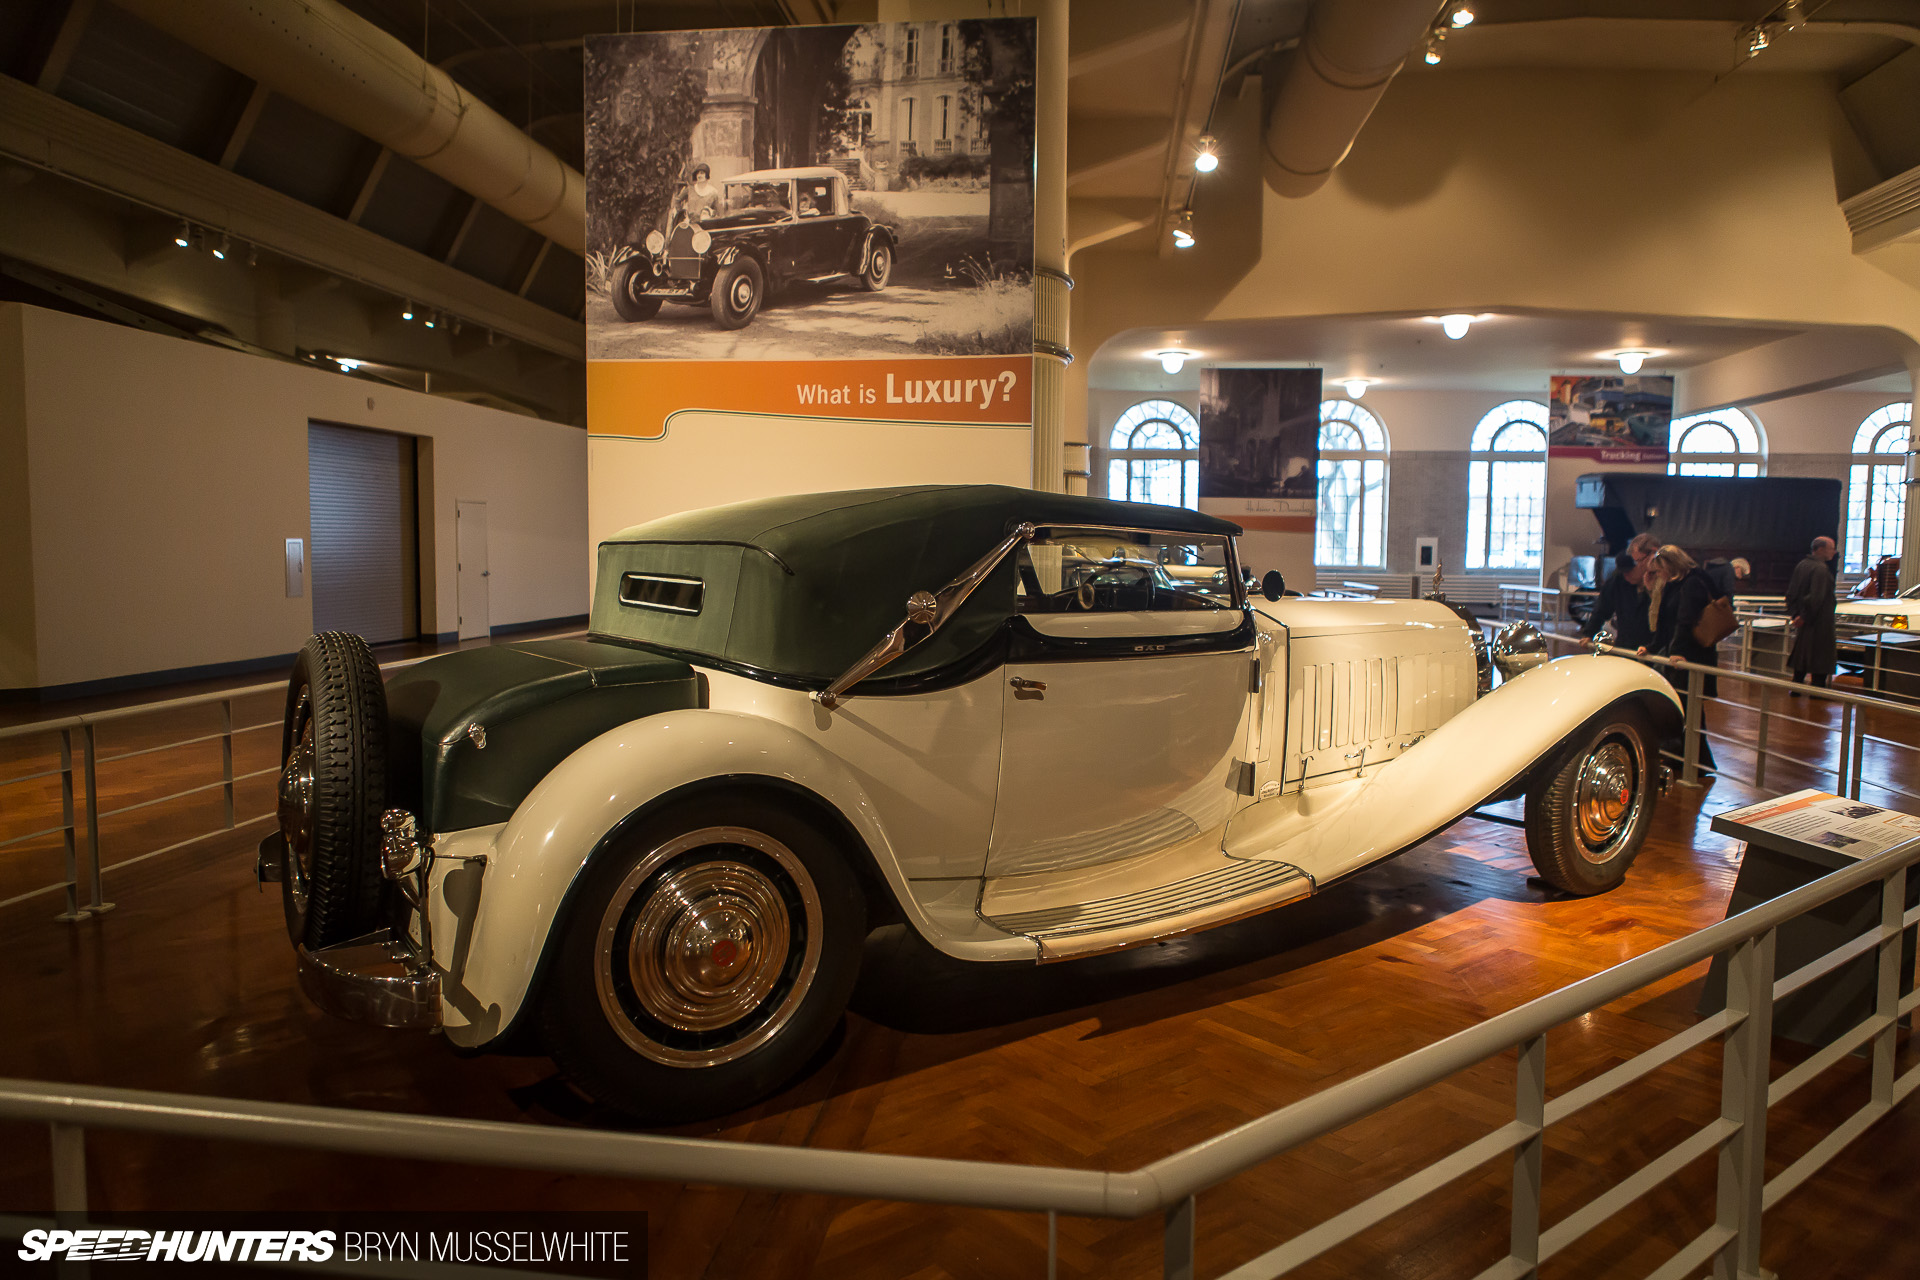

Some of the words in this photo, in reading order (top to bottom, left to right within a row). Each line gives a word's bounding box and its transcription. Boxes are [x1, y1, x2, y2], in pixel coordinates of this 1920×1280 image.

[796, 383, 851, 404] What
[858, 384, 877, 404] is
[885, 370, 1017, 410] Luxury?
[1601, 450, 1641, 462] Trucking
